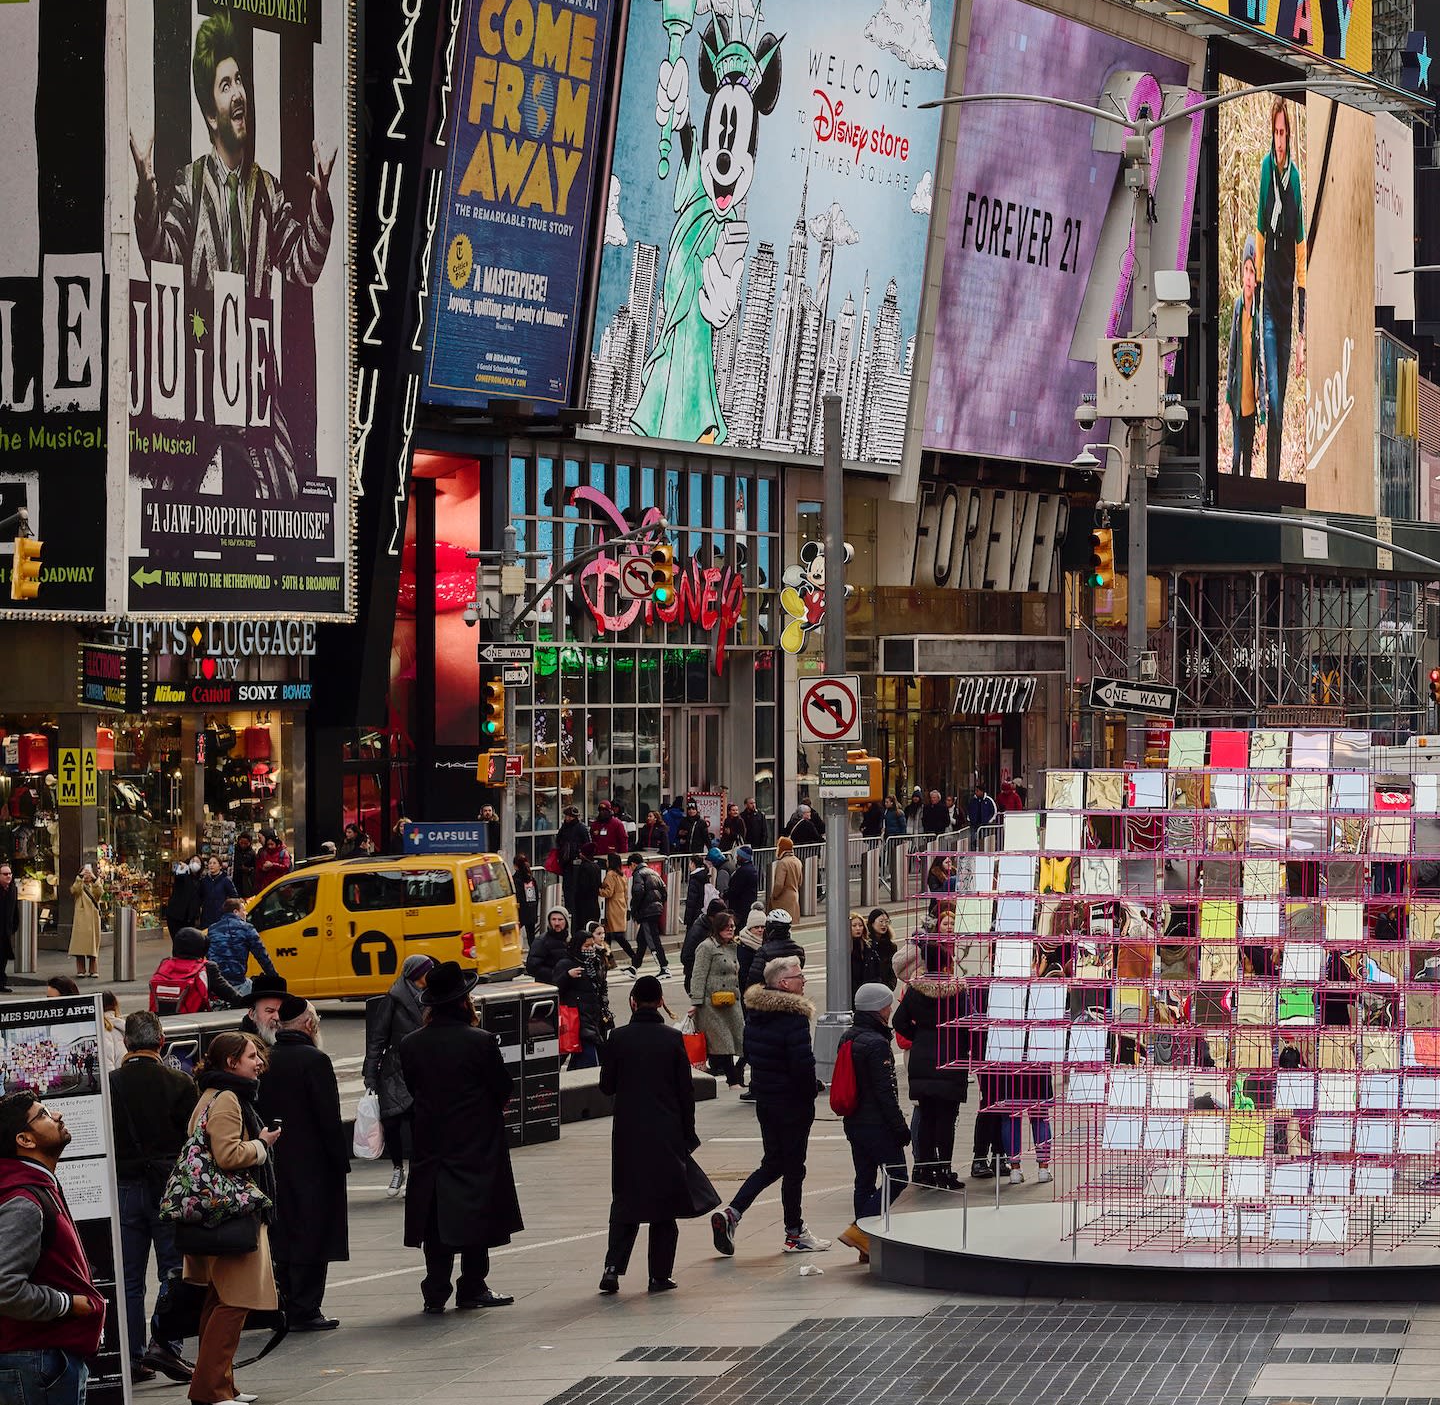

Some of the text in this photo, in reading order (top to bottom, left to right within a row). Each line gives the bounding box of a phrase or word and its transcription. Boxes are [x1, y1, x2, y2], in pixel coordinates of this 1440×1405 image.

[808, 49, 911, 109] WELCOME
[467, 56, 590, 150] FROM
[797, 89, 910, 165] TO Disney store
[457, 129, 583, 216] AWAY
[791, 148, 910, 192] AT TIMES SQUARE
[455, 204, 574, 238] THE REMARKABLE TRUE STORY
[961, 191, 1082, 275] FOREVER 21
[483, 266, 549, 303] MASTERPIECE!
[447, 292, 502, 320] Joyous, uplifting
[28, 426, 108, 451] Musical.
[129, 433, 199, 456] The Musical.
[163, 506, 258, 539] JAW-DROPPING
[911, 481, 1071, 593] FOREVER
[165, 572, 340, 592] THIS WAY TO THE NETHERWORLD 50TH BROADWAY
[113, 621, 317, 656] GIFTS LUGGAGE
[486, 647, 528, 660] ONE WAY
[216, 658, 240, 679] NY
[154, 684, 312, 703] Nikon Canon SONY BOWER
[952, 677, 1021, 715] FOREVER
[1104, 687, 1166, 707] ONE WAY
[63, 751, 77, 797] ATM
[85, 751, 95, 797] ATM
[839, 771, 862, 781] Square
[428, 829, 479, 843] CAPSULE
[276, 947, 298, 957] NYC
[23, 1004, 96, 1021] SQUARE ARTS
